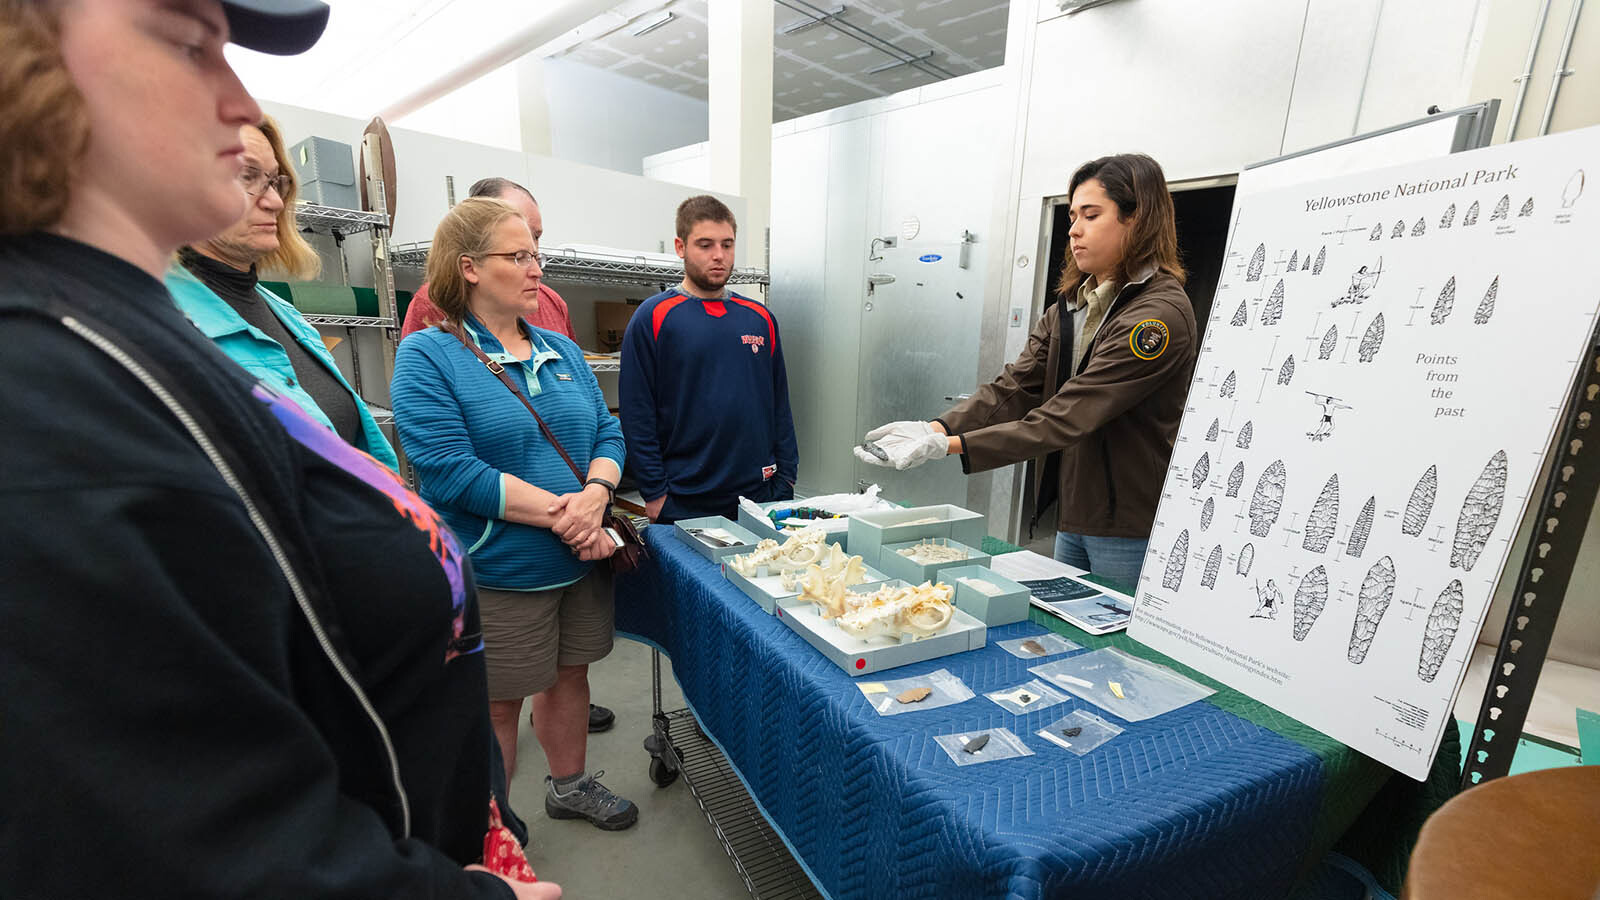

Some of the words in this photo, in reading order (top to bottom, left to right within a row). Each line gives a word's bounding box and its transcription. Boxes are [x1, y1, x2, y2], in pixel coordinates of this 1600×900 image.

[1304, 188, 1390, 213] Yellowstone
[1394, 172, 1469, 198] National
[1472, 164, 1519, 186] Park
[1415, 353, 1458, 365] Points
[1425, 369, 1459, 383] from
[1431, 387, 1453, 399] the
[1434, 407, 1466, 418] past
[1195, 632, 1225, 650] Yellowstone
[1225, 646, 1248, 661] National
[1248, 656, 1266, 669] Park's
